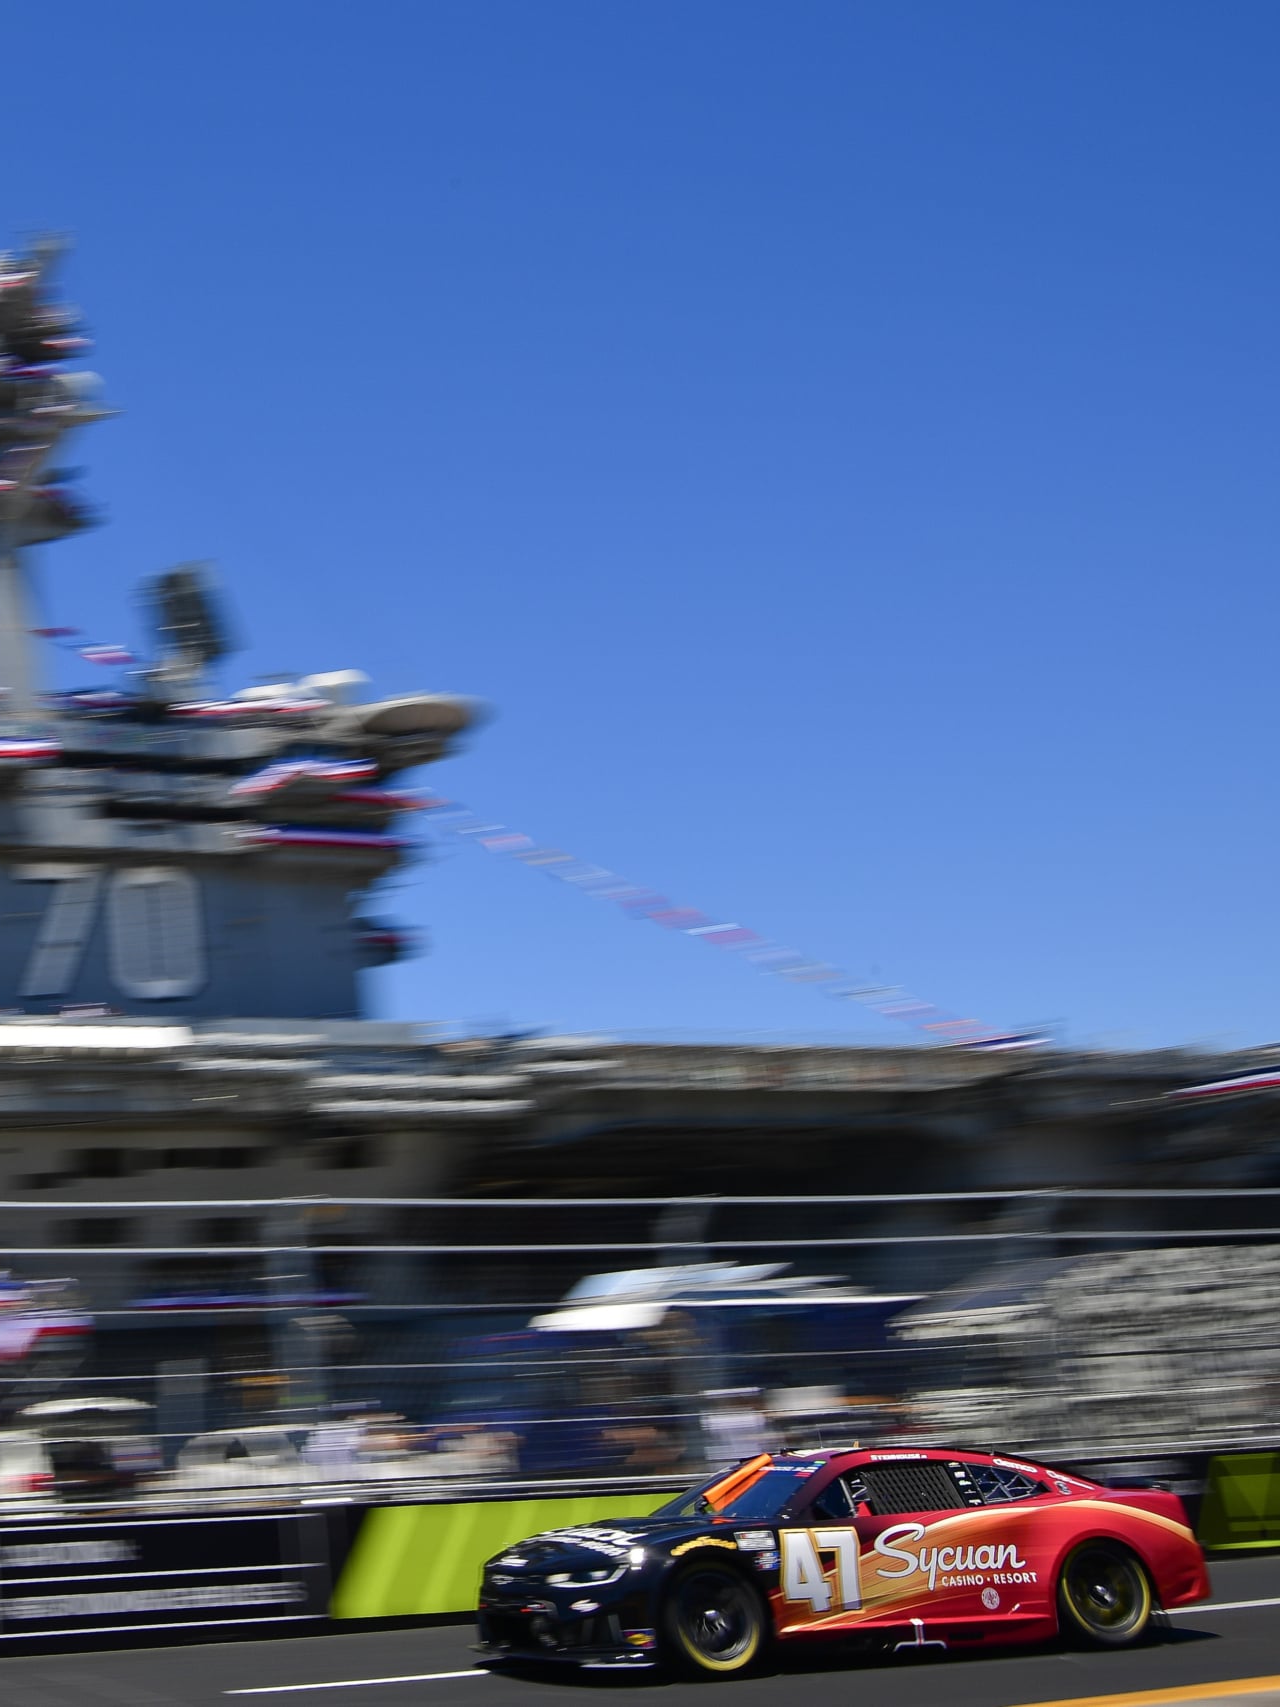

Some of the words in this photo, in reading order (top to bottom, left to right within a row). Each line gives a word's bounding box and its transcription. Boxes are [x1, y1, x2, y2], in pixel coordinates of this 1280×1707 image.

[12, 862, 203, 1000] 70
[779, 1526, 863, 1613] 47
[874, 1522, 1026, 1592] Sycuan
[941, 1574, 984, 1587] CASINO
[993, 1571, 1038, 1585] RESORT
